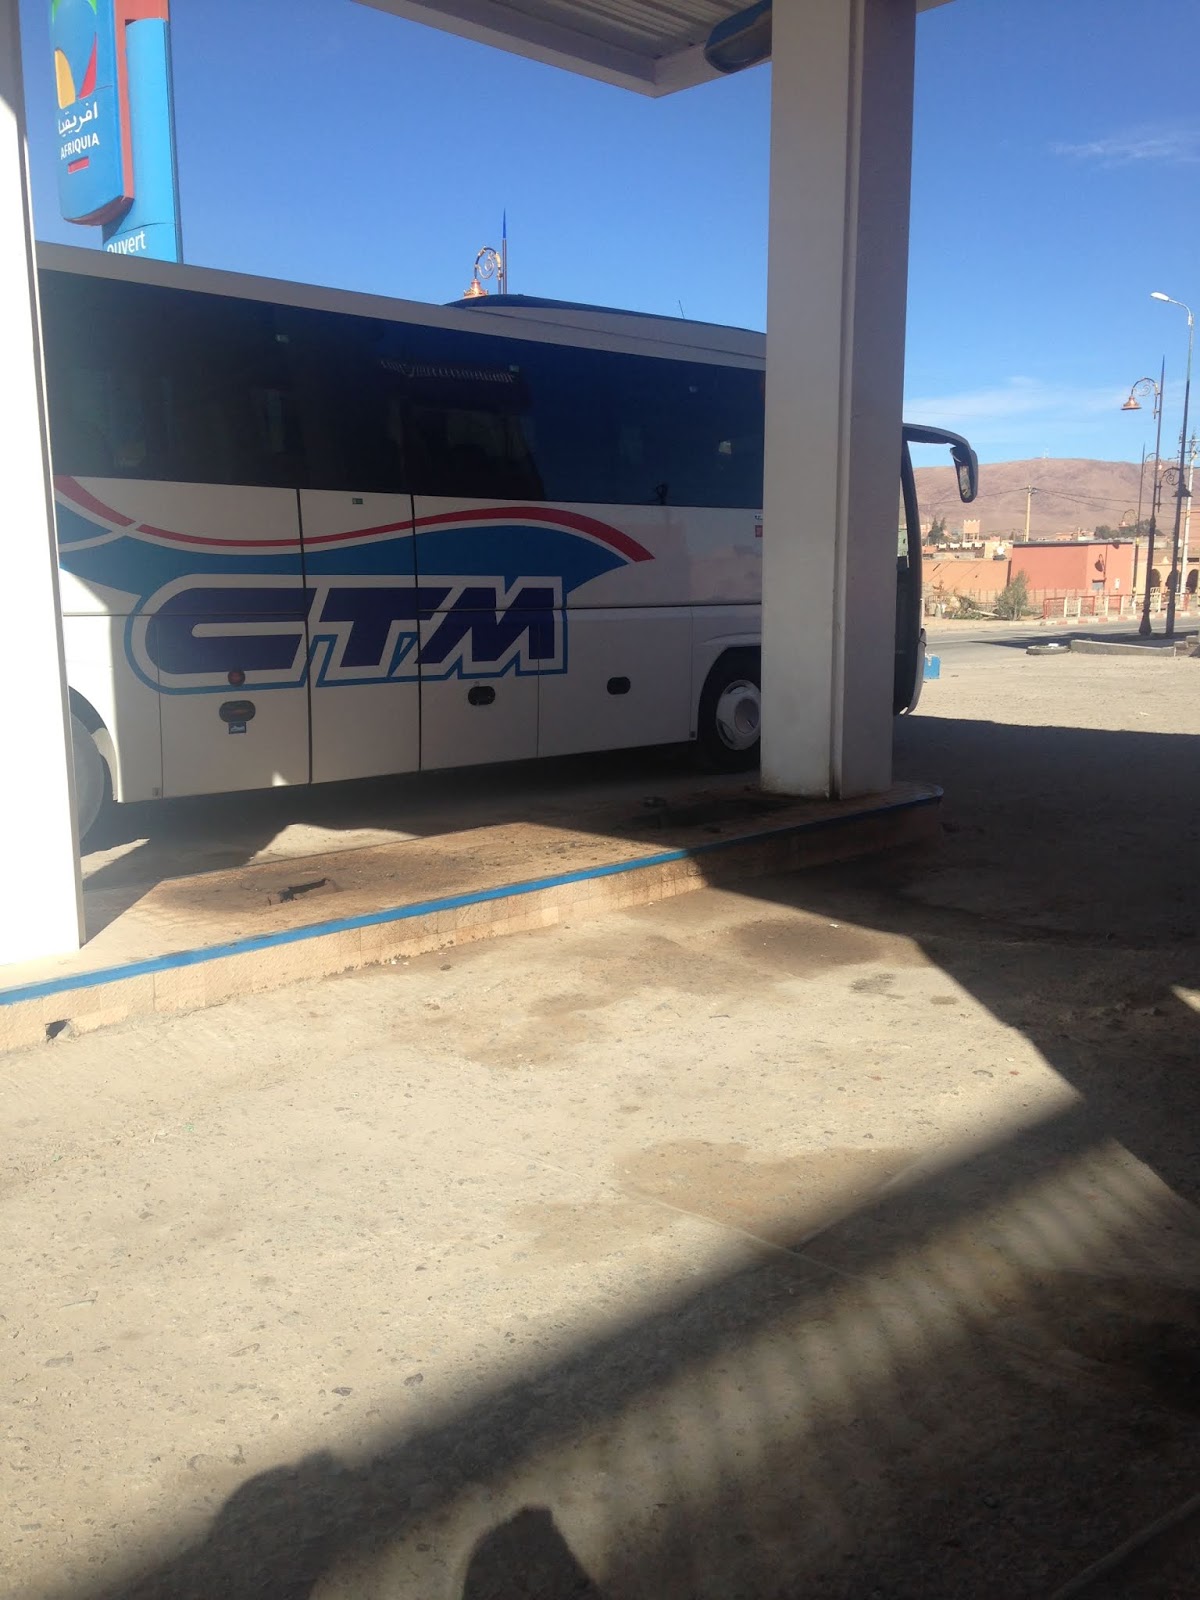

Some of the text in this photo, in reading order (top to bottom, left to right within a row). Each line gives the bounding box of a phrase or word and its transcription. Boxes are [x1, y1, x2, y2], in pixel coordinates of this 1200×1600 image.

[58, 101, 98, 137] افريقيا
[60, 132, 100, 160] AFRIQUIA
[106, 230, 146, 254] ouvert
[142, 585, 558, 677] CTM
